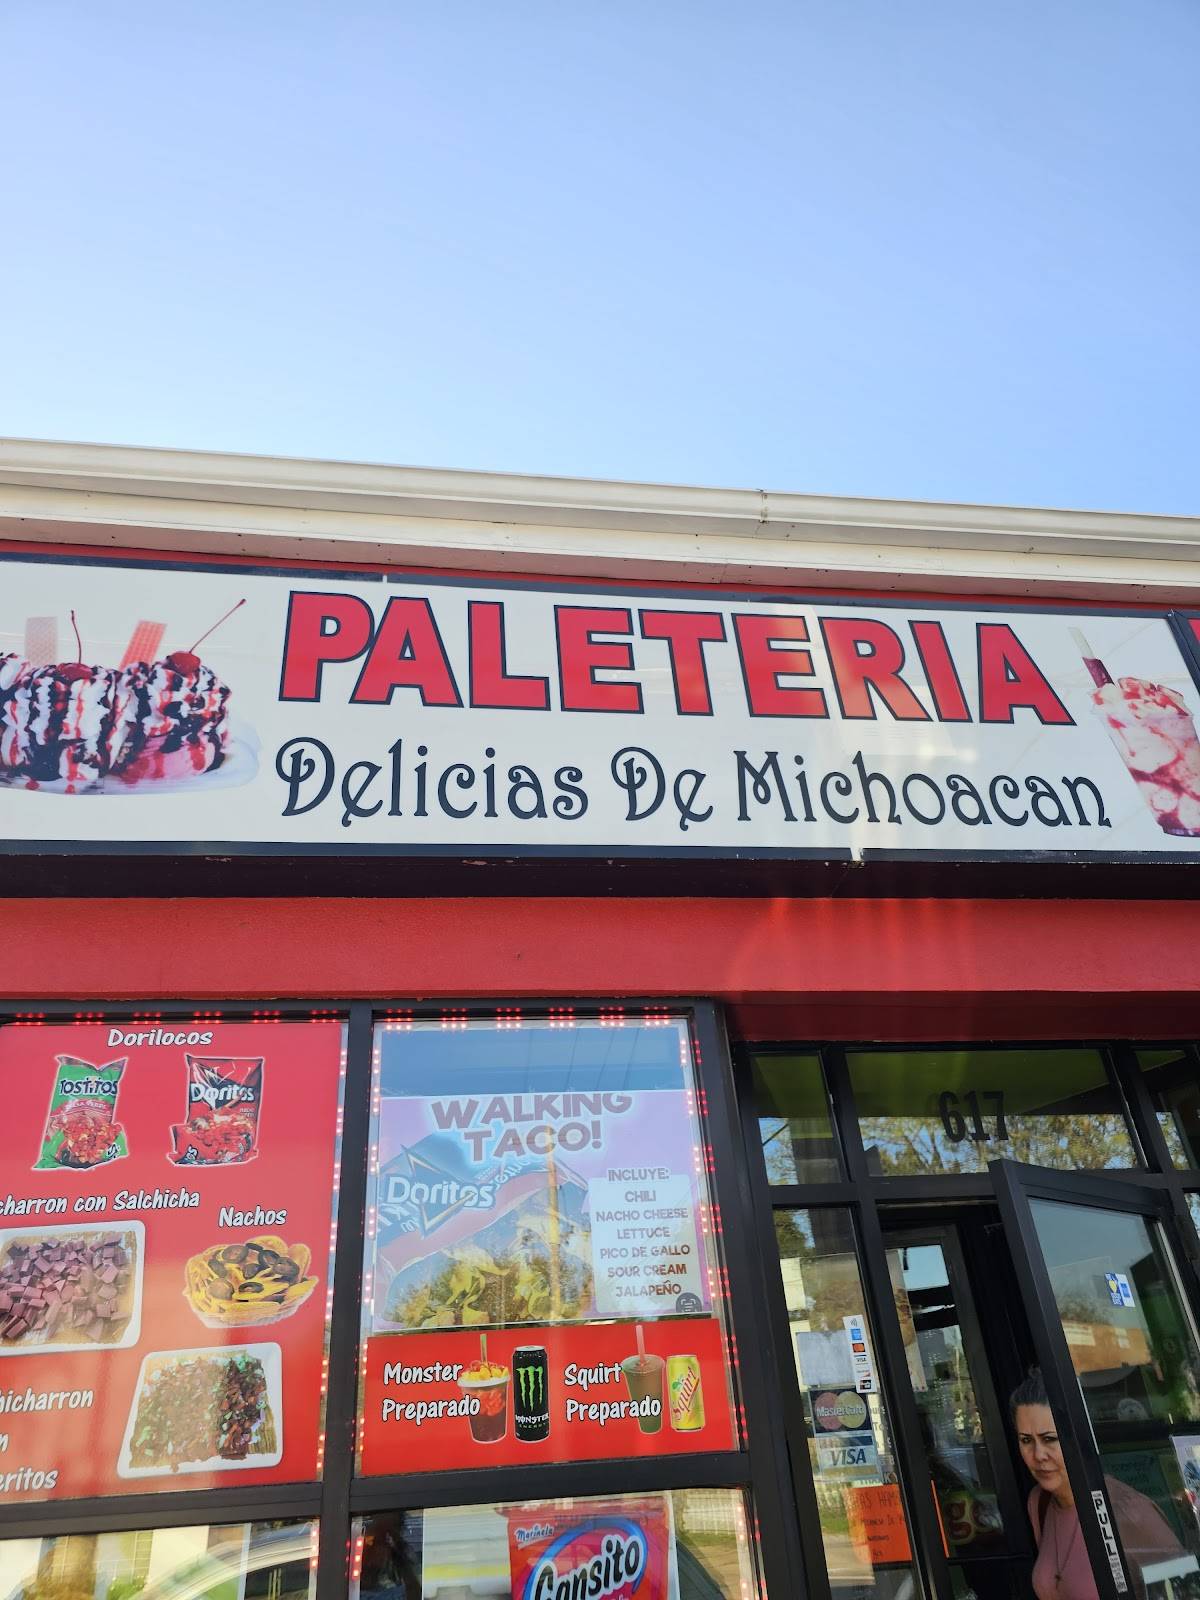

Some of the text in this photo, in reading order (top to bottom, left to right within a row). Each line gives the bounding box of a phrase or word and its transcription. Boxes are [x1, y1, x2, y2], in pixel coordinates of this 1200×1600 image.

[278, 590, 1077, 726] PALETERIA
[275, 736, 1112, 831] Delicias De Michoacan
[107, 1028, 213, 1047] Dorilocos
[190, 1083, 255, 1103] Doritos
[431, 1092, 633, 1130] WALKING
[939, 1090, 1009, 1142] 617
[464, 1120, 602, 1162] TACO!
[608, 1167, 669, 1181] INCLUYE:
[73, 1196, 107, 1213] con
[113, 1187, 200, 1211] Salchicha
[387, 1175, 496, 1208] Doritos
[624, 1190, 656, 1203] CHILI
[218, 1206, 287, 1228] Nachos
[596, 1208, 688, 1222] NACHO CHEESE
[617, 1227, 671, 1240] LETTUCE
[600, 1244, 690, 1259] PICO DE GALLO
[607, 1263, 687, 1278] SOUR CREAM
[616, 1280, 681, 1297] JALAPEÑO
[383, 1361, 463, 1385] Monster
[564, 1361, 623, 1387] Squirt
[382, 1395, 480, 1425] Preparado
[565, 1395, 662, 1425] Preparado
[830, 1448, 867, 1467] VISA
[515, 1524, 554, 1541] Marinela
[1094, 1498, 1117, 1557] PULL
